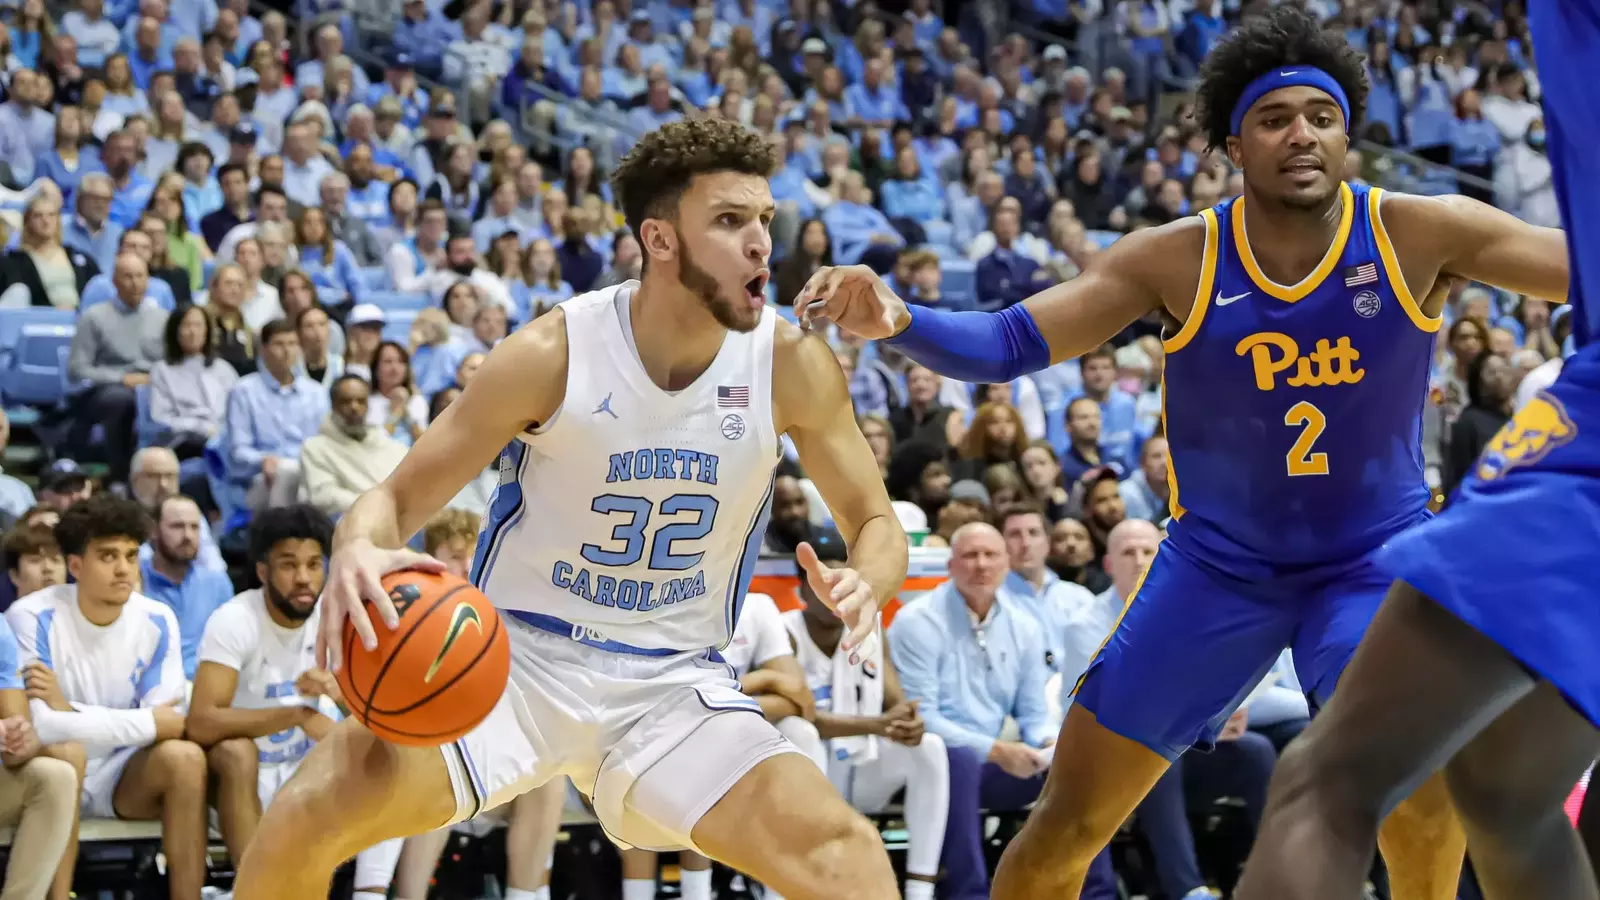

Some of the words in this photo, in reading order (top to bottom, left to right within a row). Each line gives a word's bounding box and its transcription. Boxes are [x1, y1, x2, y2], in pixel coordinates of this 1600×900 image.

[1235, 332, 1365, 391] Pitt
[606, 448, 719, 485] NORTH
[1284, 401, 1329, 476] 2
[580, 493, 719, 570] 32
[552, 560, 706, 611] CAROLINA
